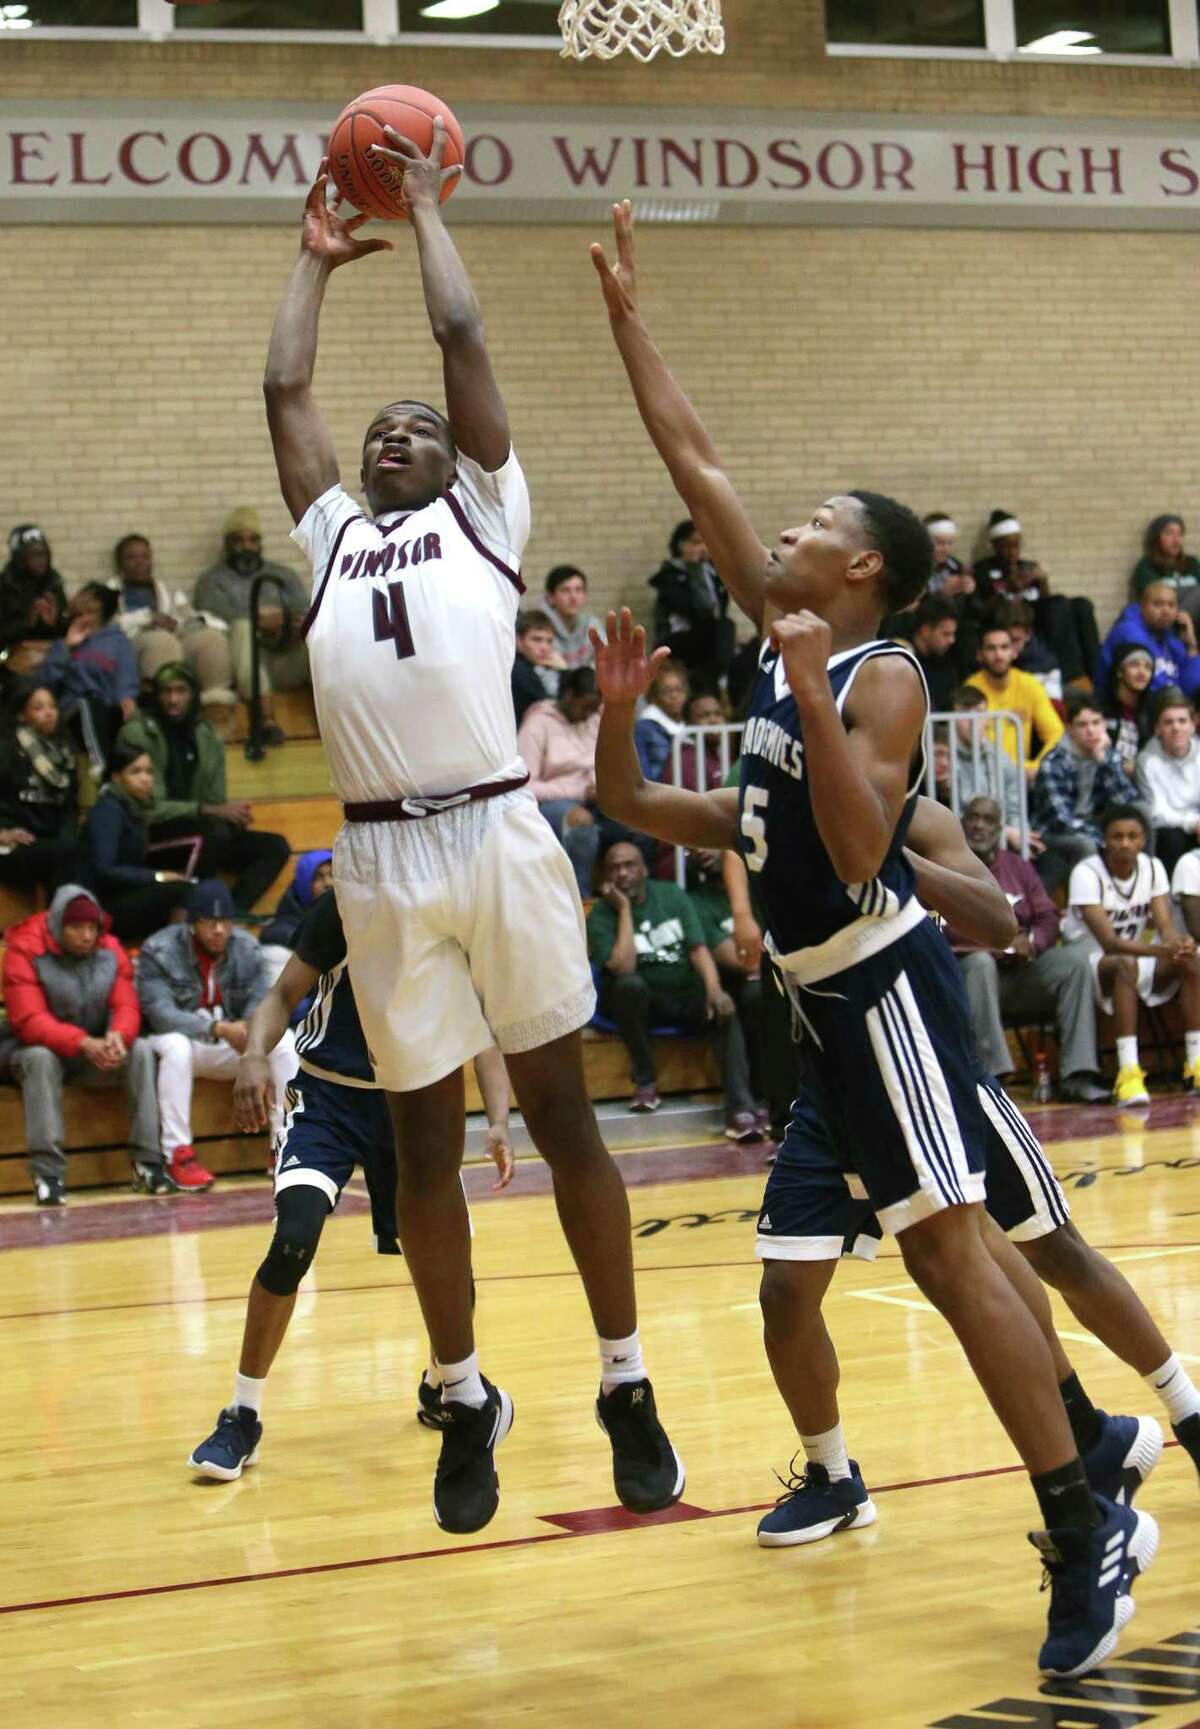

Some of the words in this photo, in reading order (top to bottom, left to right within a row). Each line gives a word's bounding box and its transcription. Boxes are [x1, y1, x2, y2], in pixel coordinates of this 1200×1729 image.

[463, 133, 514, 187] O
[552, 136, 915, 192] WINDSOR
[952, 143, 1125, 195] HIGH
[371, 580, 417, 660] 4
[740, 784, 770, 873] 5
